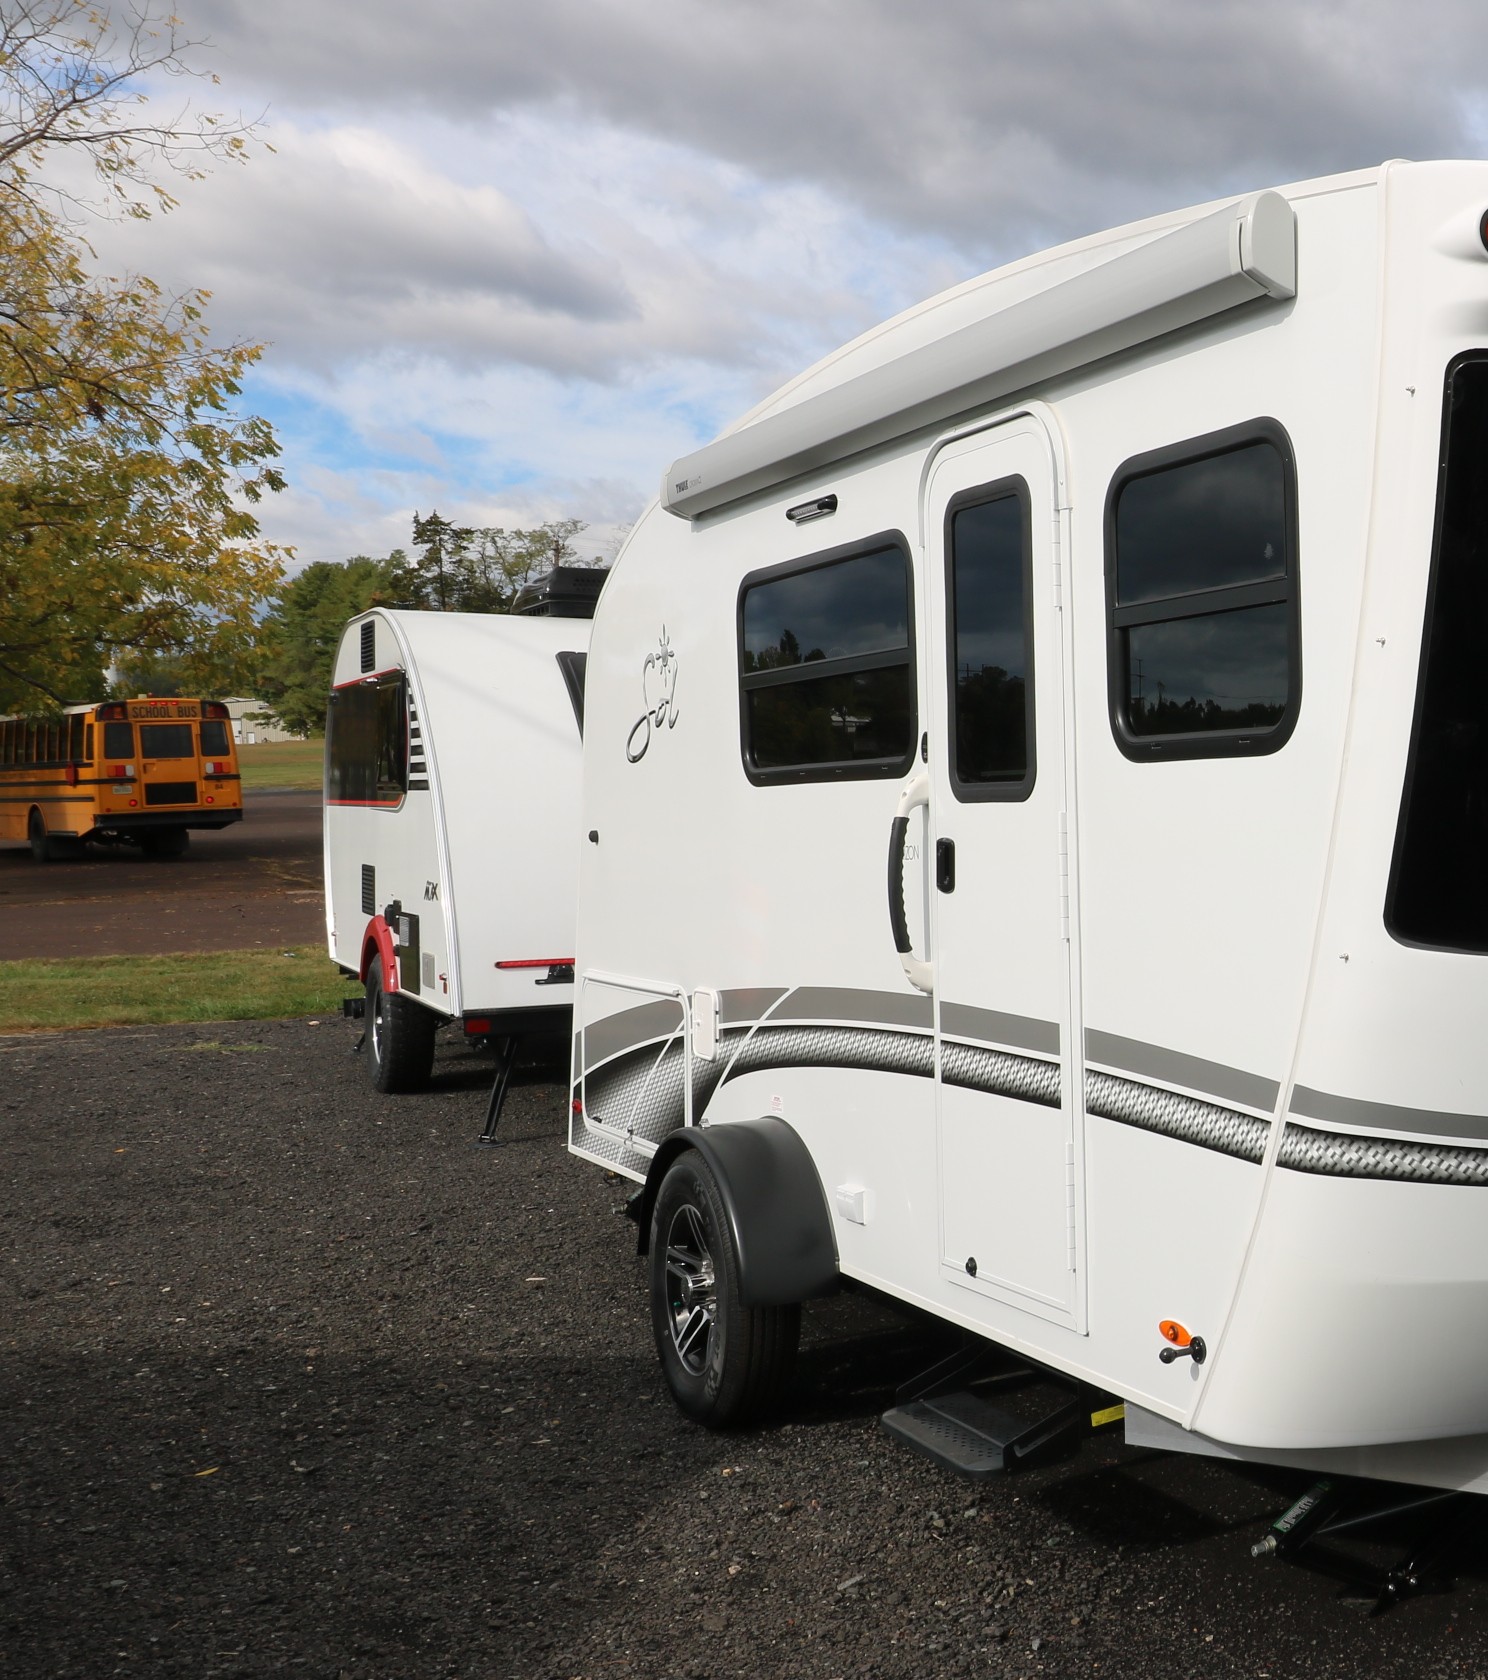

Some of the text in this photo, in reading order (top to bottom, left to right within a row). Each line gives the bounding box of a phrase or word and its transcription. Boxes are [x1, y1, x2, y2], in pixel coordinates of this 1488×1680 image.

[132, 706, 197, 718] SCHOOL BUS
[626, 652, 679, 763] Sol
